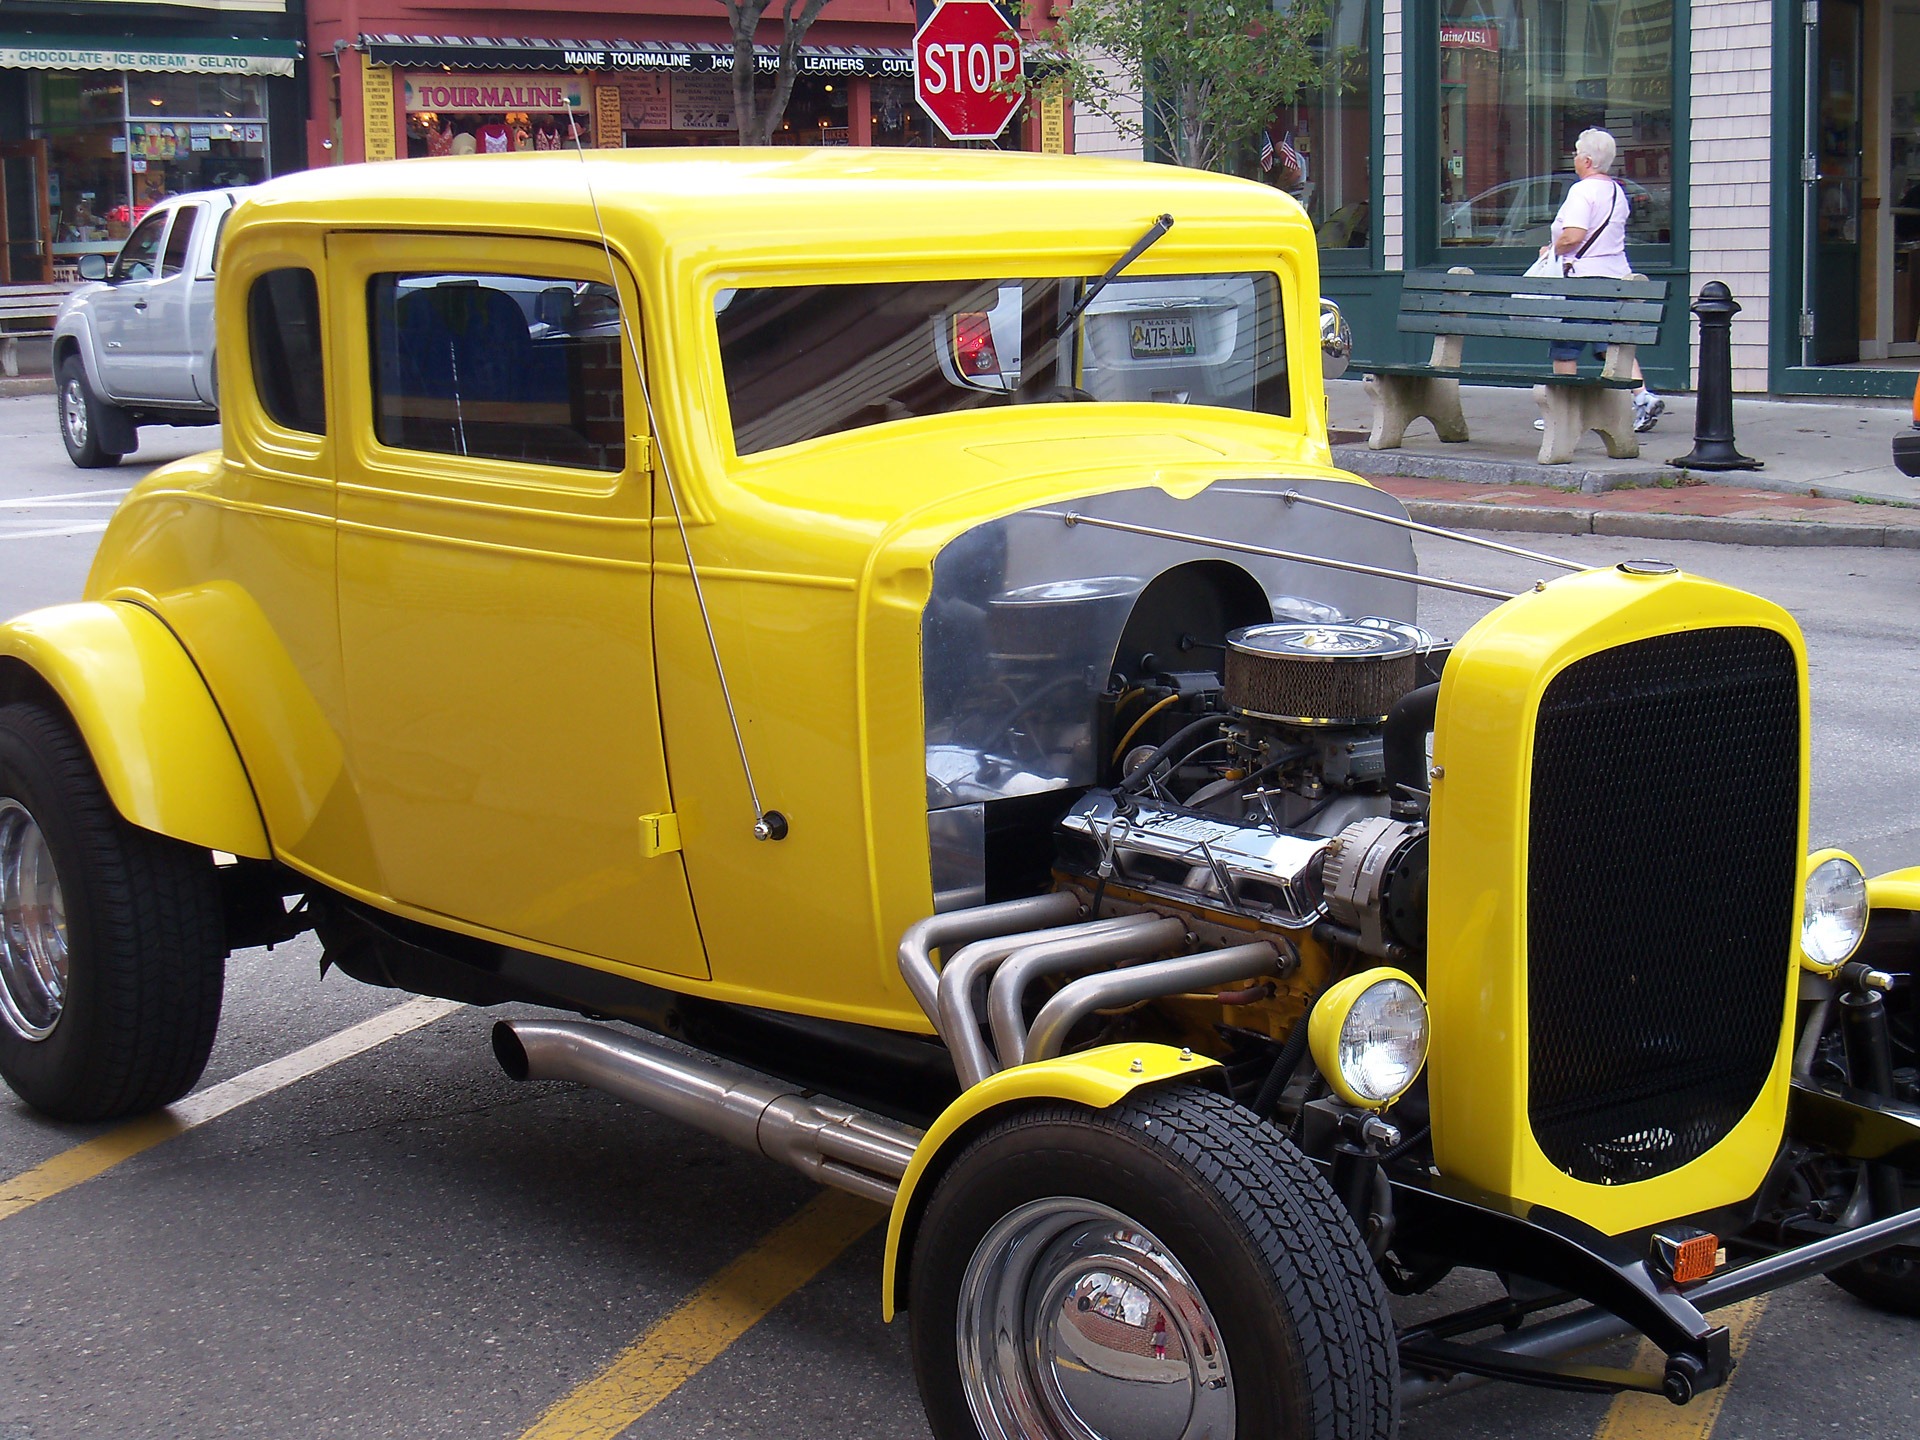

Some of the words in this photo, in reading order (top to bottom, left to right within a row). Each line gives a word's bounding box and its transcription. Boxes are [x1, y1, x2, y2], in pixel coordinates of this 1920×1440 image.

[19, 51, 103, 63] CHOCOLATE
[114, 53, 136, 65] ICE
[140, 54, 187, 67] CREAM
[199, 56, 249, 68] GELATO
[564, 51, 605, 65] MAINE
[611, 53, 691, 67] TOURMALINE
[758, 56, 780, 70] Hyd
[804, 57, 864, 71] LEATHERS
[924, 43, 1016, 94] STOP
[419, 86, 564, 108] TOURMALINE
